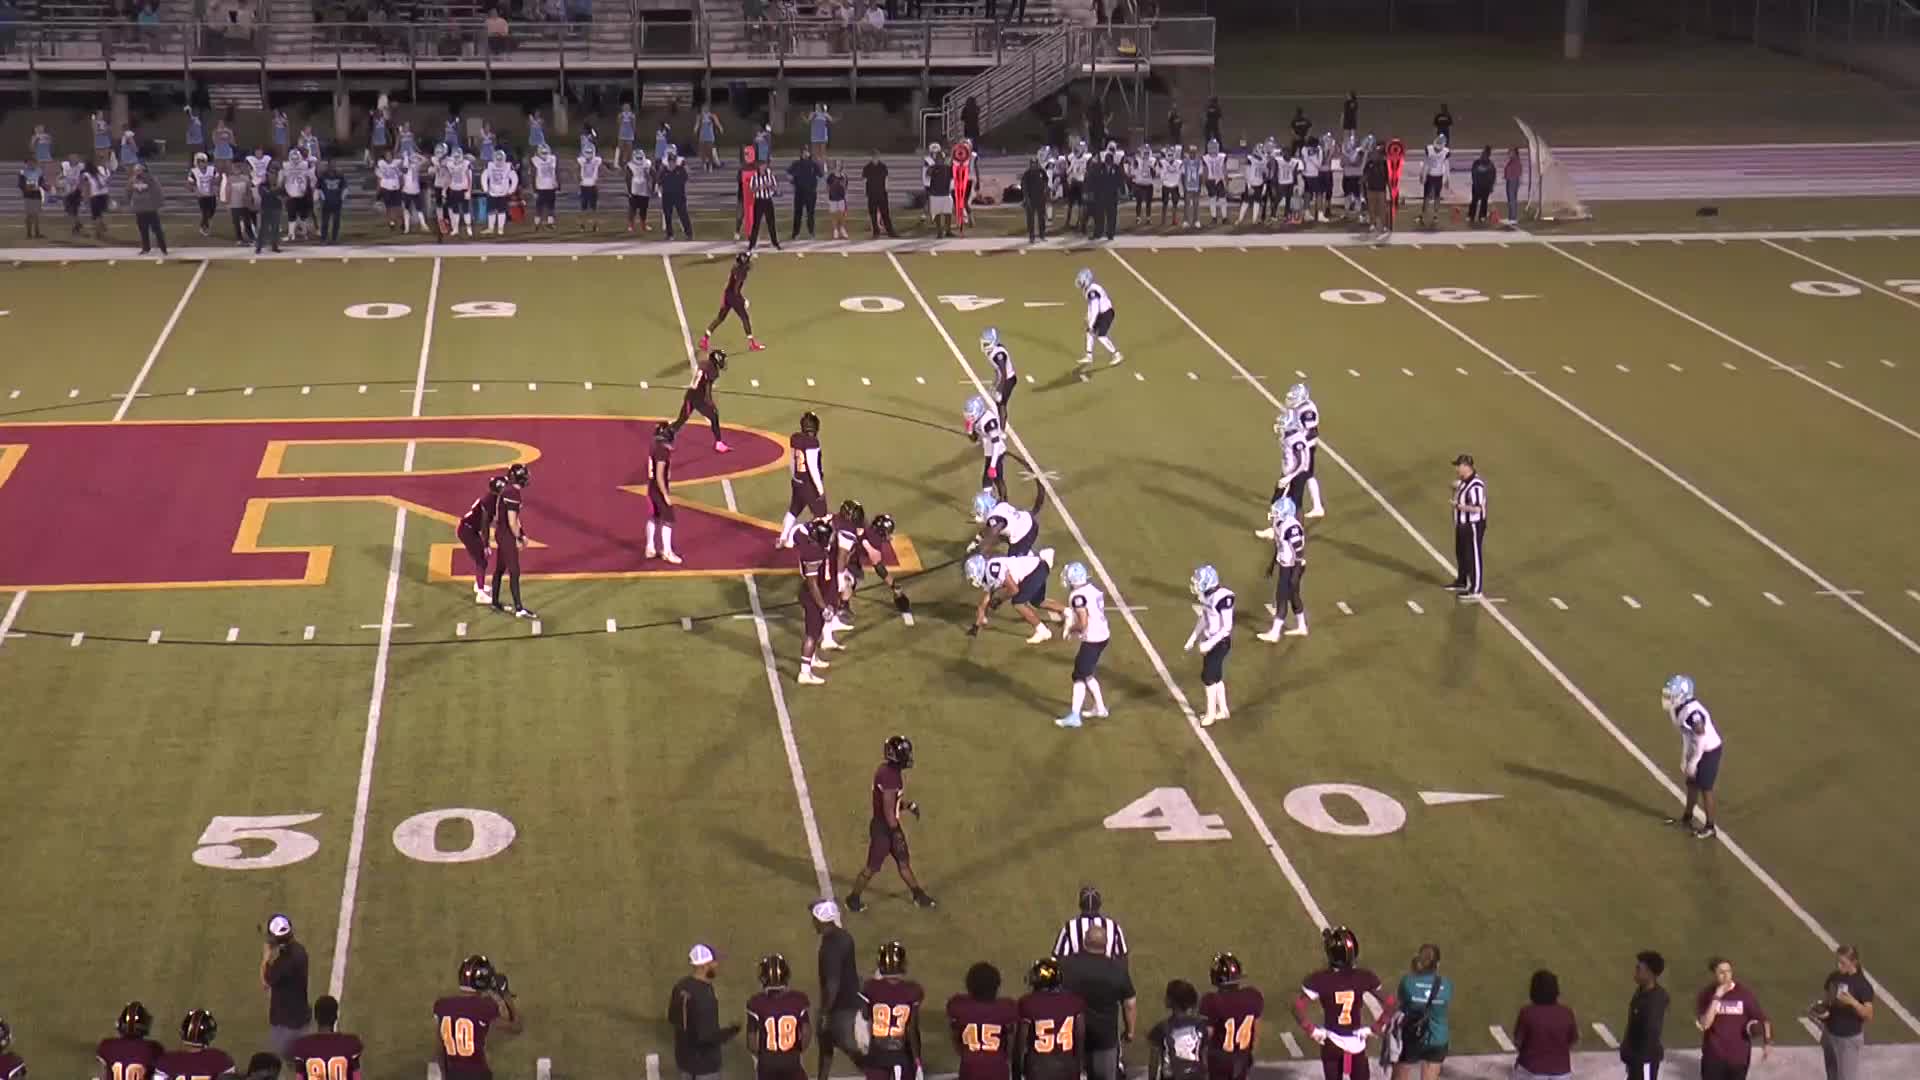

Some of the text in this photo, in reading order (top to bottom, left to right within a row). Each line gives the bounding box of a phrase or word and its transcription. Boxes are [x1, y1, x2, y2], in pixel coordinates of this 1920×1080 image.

[1335, 991, 1355, 1025] 7
[1034, 1015, 1075, 1053] 54
[1222, 1014, 1255, 1053] 14
